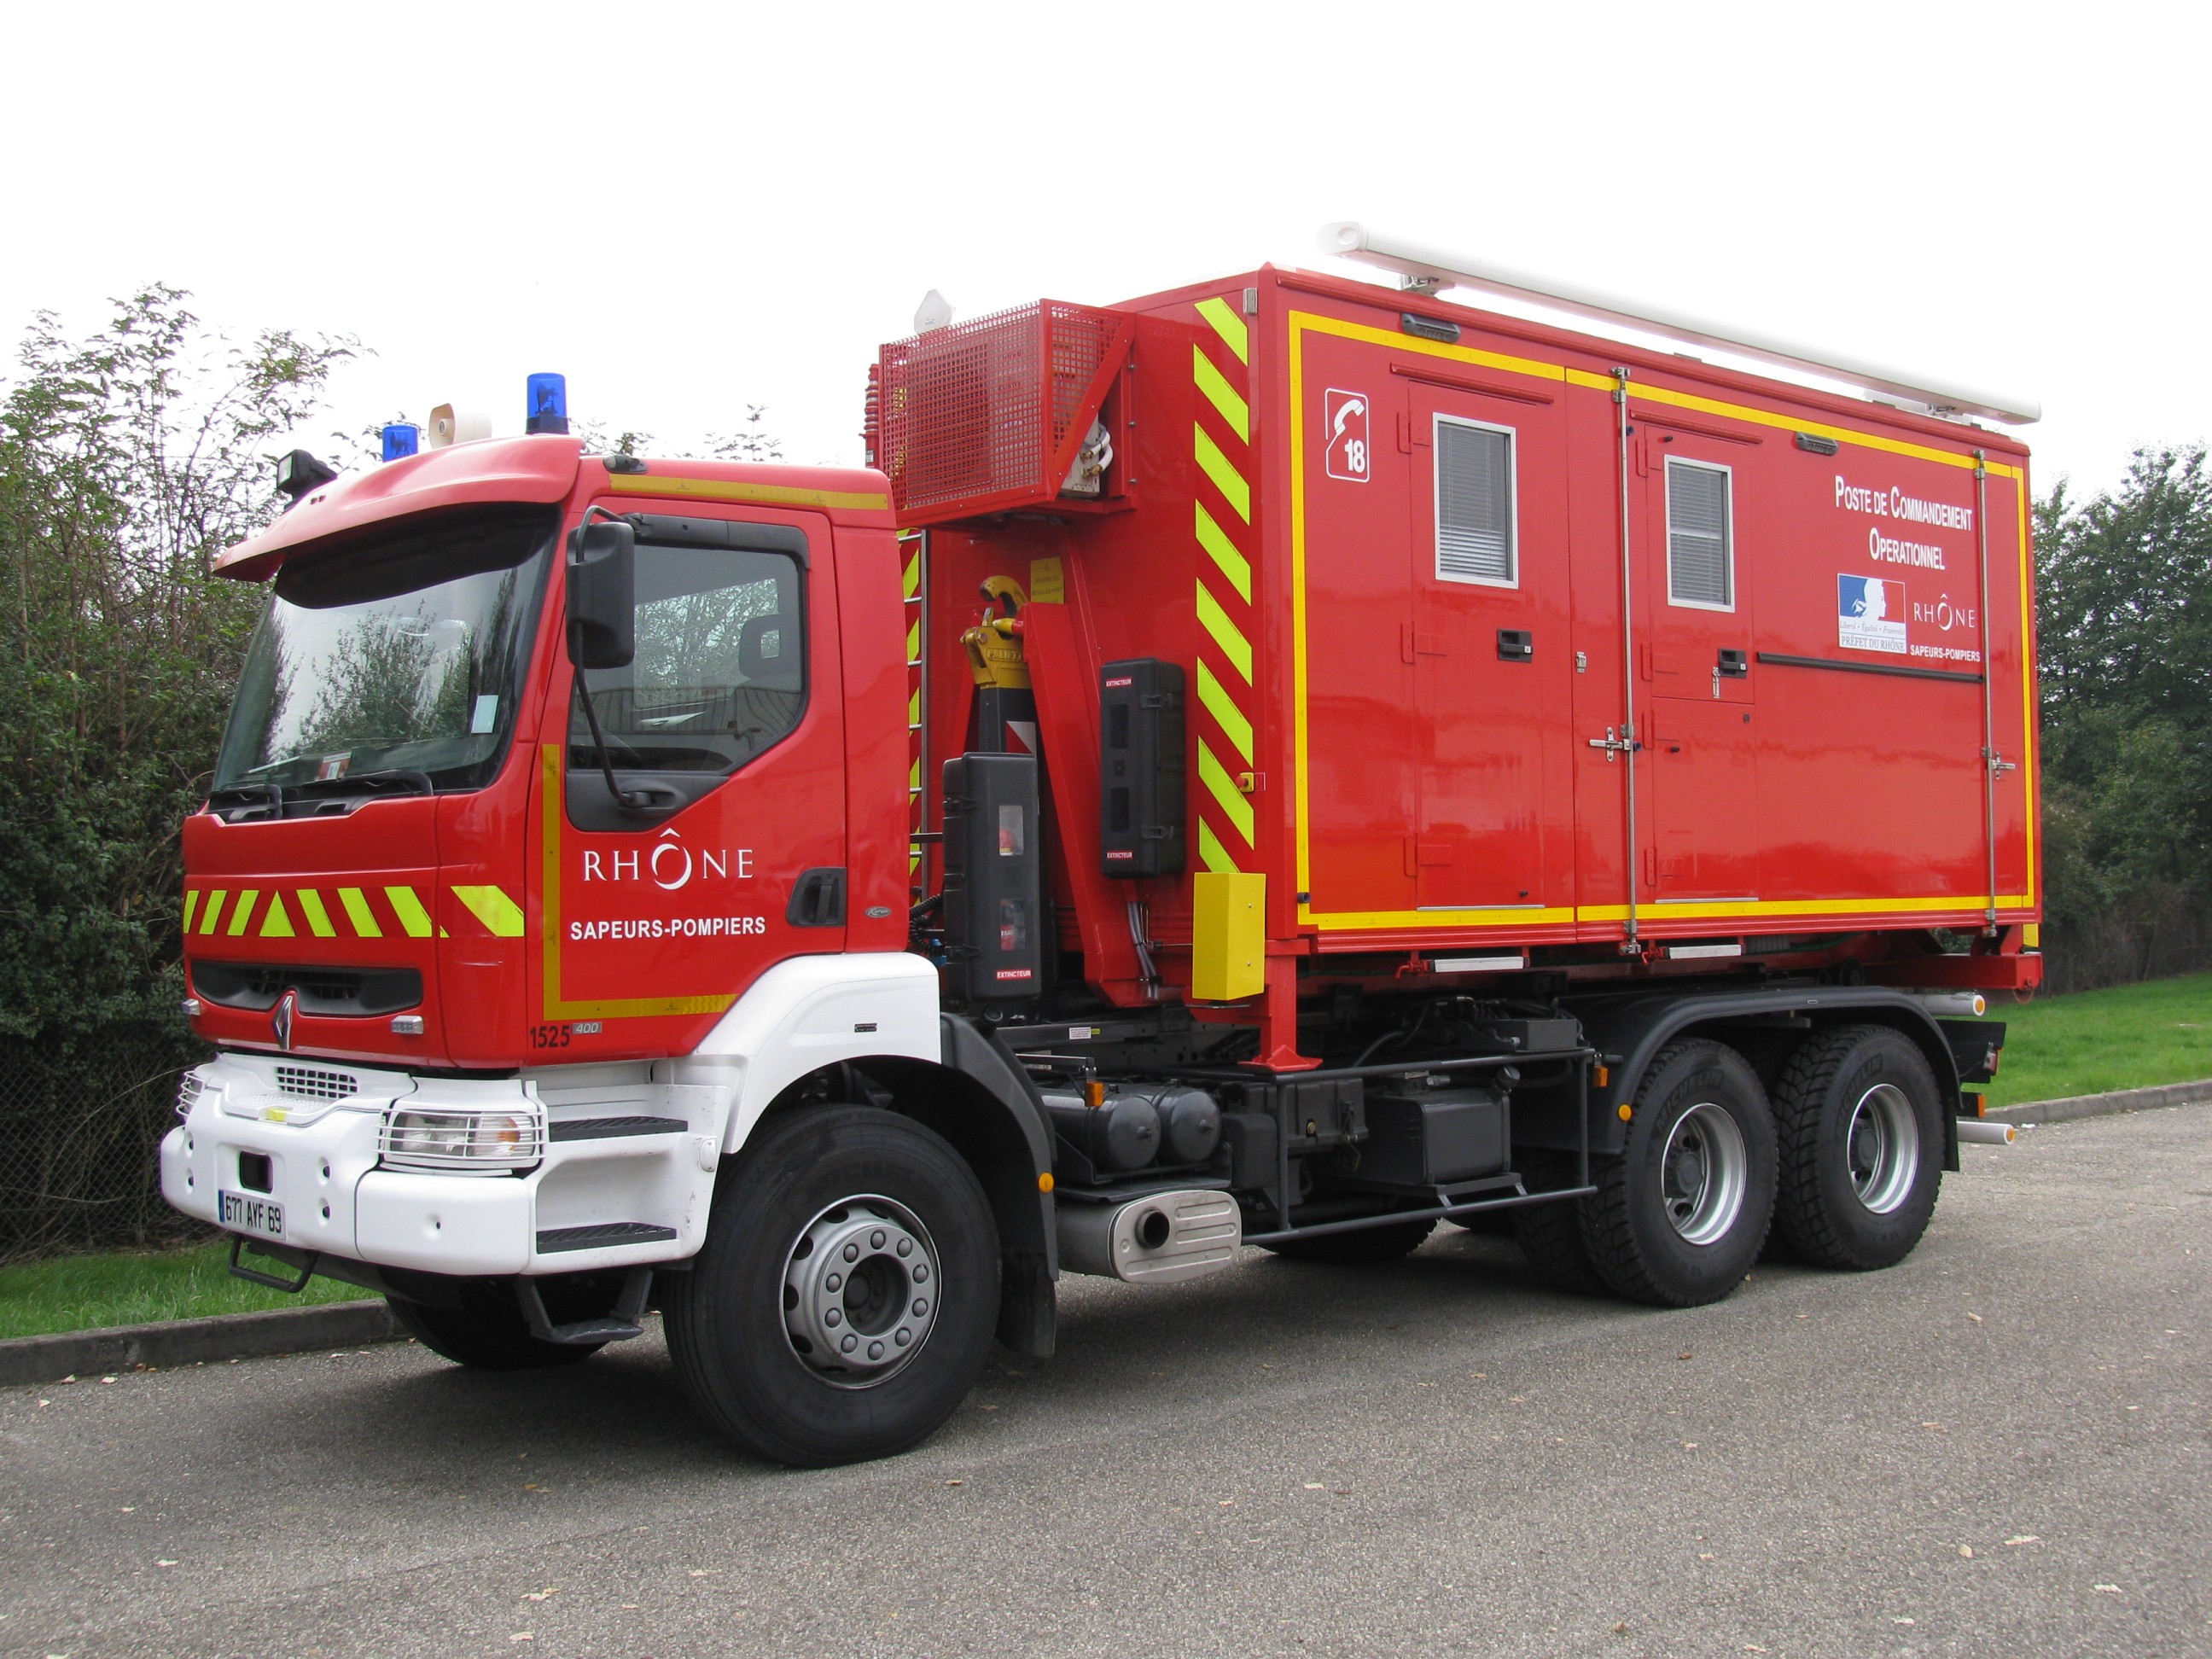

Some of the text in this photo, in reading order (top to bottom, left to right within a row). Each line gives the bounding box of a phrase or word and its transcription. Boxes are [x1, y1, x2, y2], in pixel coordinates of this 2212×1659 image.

[1344, 438, 1365, 473] 18
[1836, 475, 1972, 531] POSTE DE COMMANDEMENT
[1869, 527, 1945, 570] OPERATIONNEL
[1913, 593, 1975, 632] RHÔNE
[1841, 634, 1905, 652] PRÉFET DU RHÔNE
[1910, 644, 1981, 663] SAPEURS-POMPIERS
[584, 827, 754, 890] RHÔNE
[570, 917, 766, 940] SAPEURS-POMPIERS
[997, 970, 1031, 979] EXTINCTEUR
[530, 1026, 570, 1048] 1525
[575, 1022, 599, 1033] 400
[225, 1196, 282, 1234] 677 AYF 69
